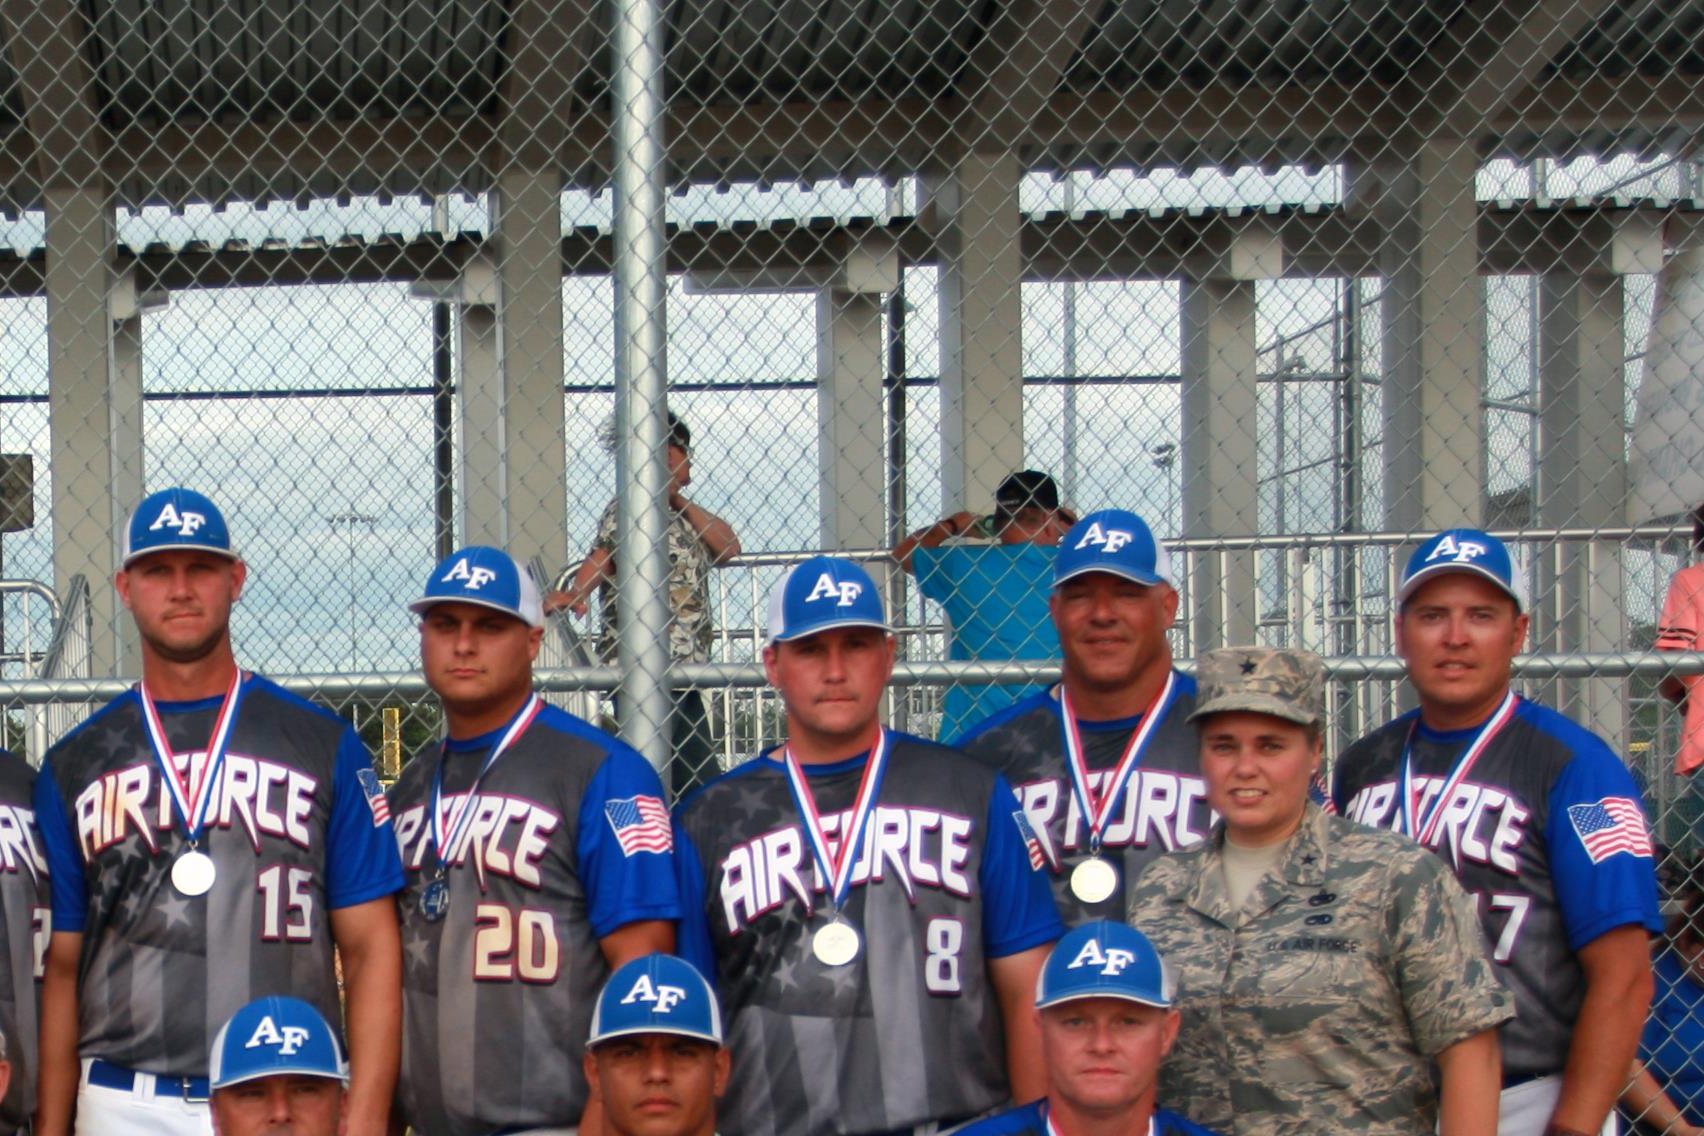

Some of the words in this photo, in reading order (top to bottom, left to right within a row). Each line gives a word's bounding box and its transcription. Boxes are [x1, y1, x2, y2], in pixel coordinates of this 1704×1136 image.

[149, 503, 206, 536] AF
[1074, 522, 1134, 554] AF
[1425, 535, 1486, 562] AF
[441, 558, 496, 590] AF
[805, 574, 862, 606] AF
[75, 763, 158, 866] AIR
[720, 825, 813, 936] AIR
[813, 805, 974, 904] FORCE
[258, 864, 313, 942] 15
[473, 904, 558, 984] 20
[925, 916, 963, 995] 8
[1067, 938, 1136, 975] AF
[1292, 937, 1314, 950] AIR
[1318, 938, 1360, 953] FORCE
[621, 974, 686, 1013] AF
[245, 1016, 309, 1055] AF
